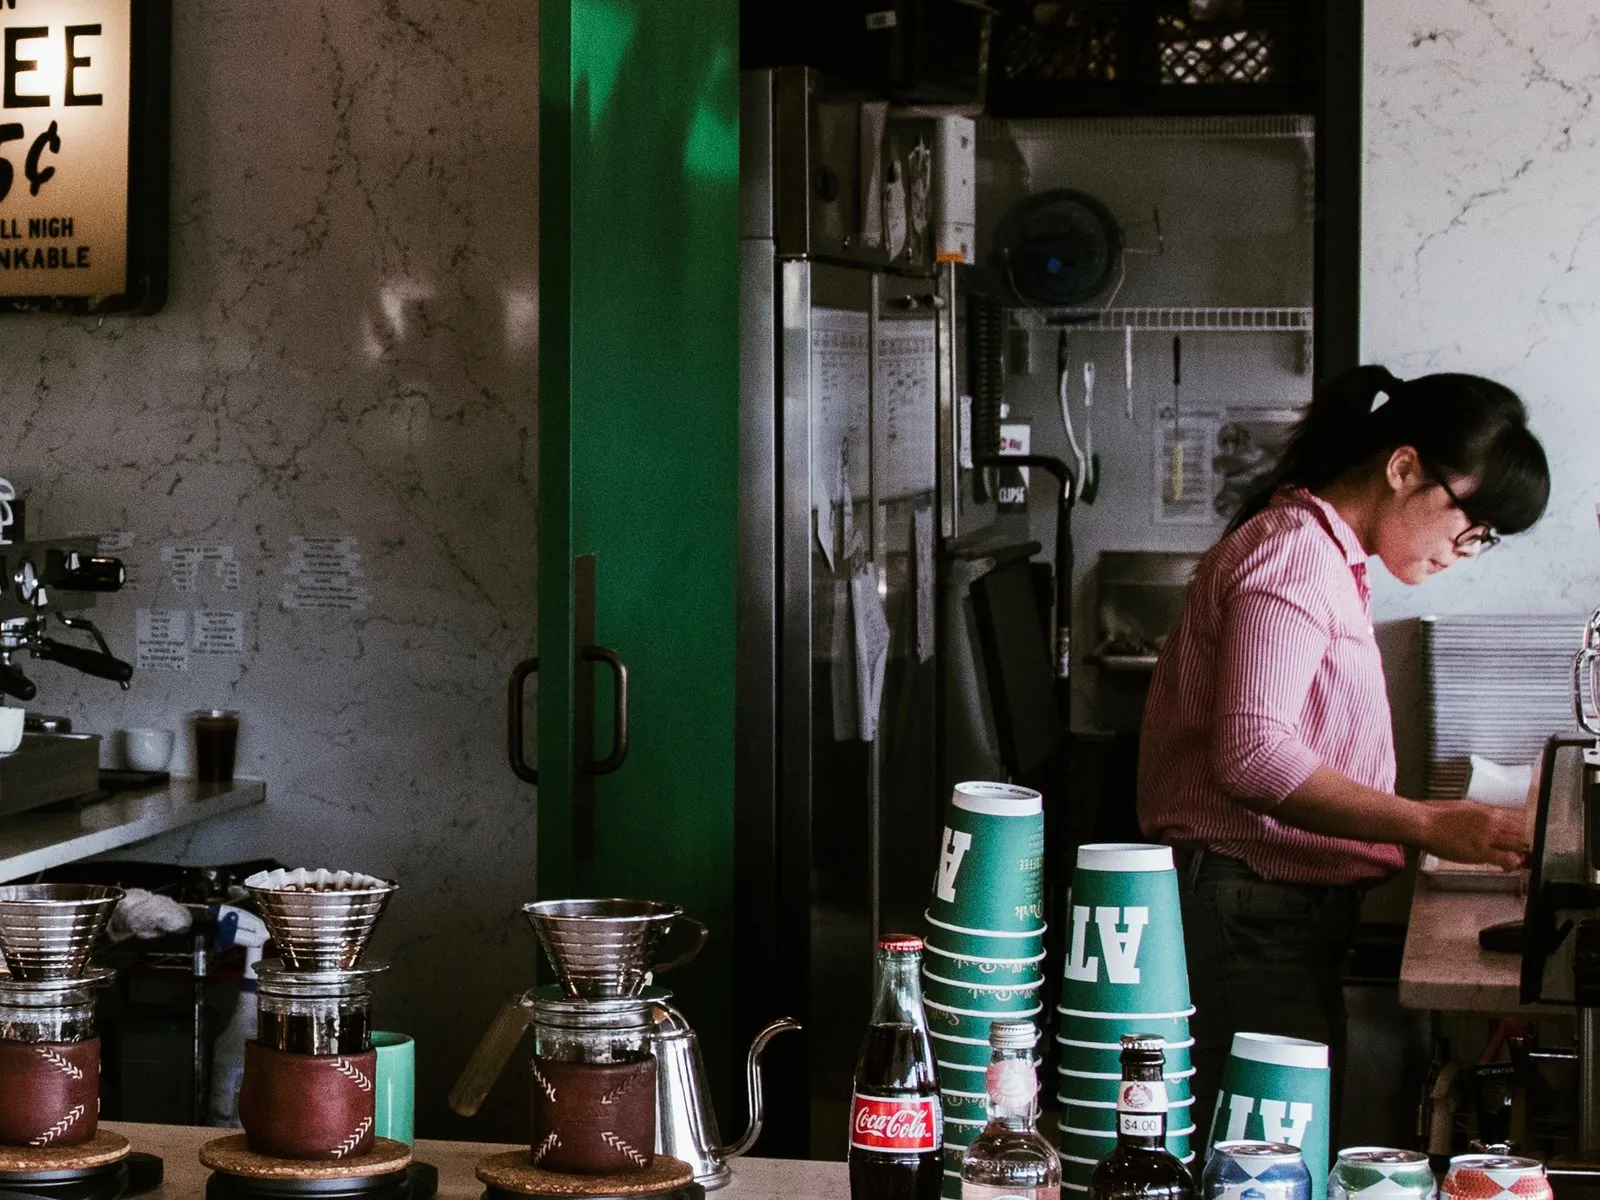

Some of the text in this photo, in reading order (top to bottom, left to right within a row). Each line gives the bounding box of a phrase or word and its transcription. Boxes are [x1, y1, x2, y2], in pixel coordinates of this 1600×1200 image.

[28, 217, 74, 238] NIGH
[855, 1107, 928, 1138] Coca-Cola
[1124, 1118, 1158, 1132] $4.00
